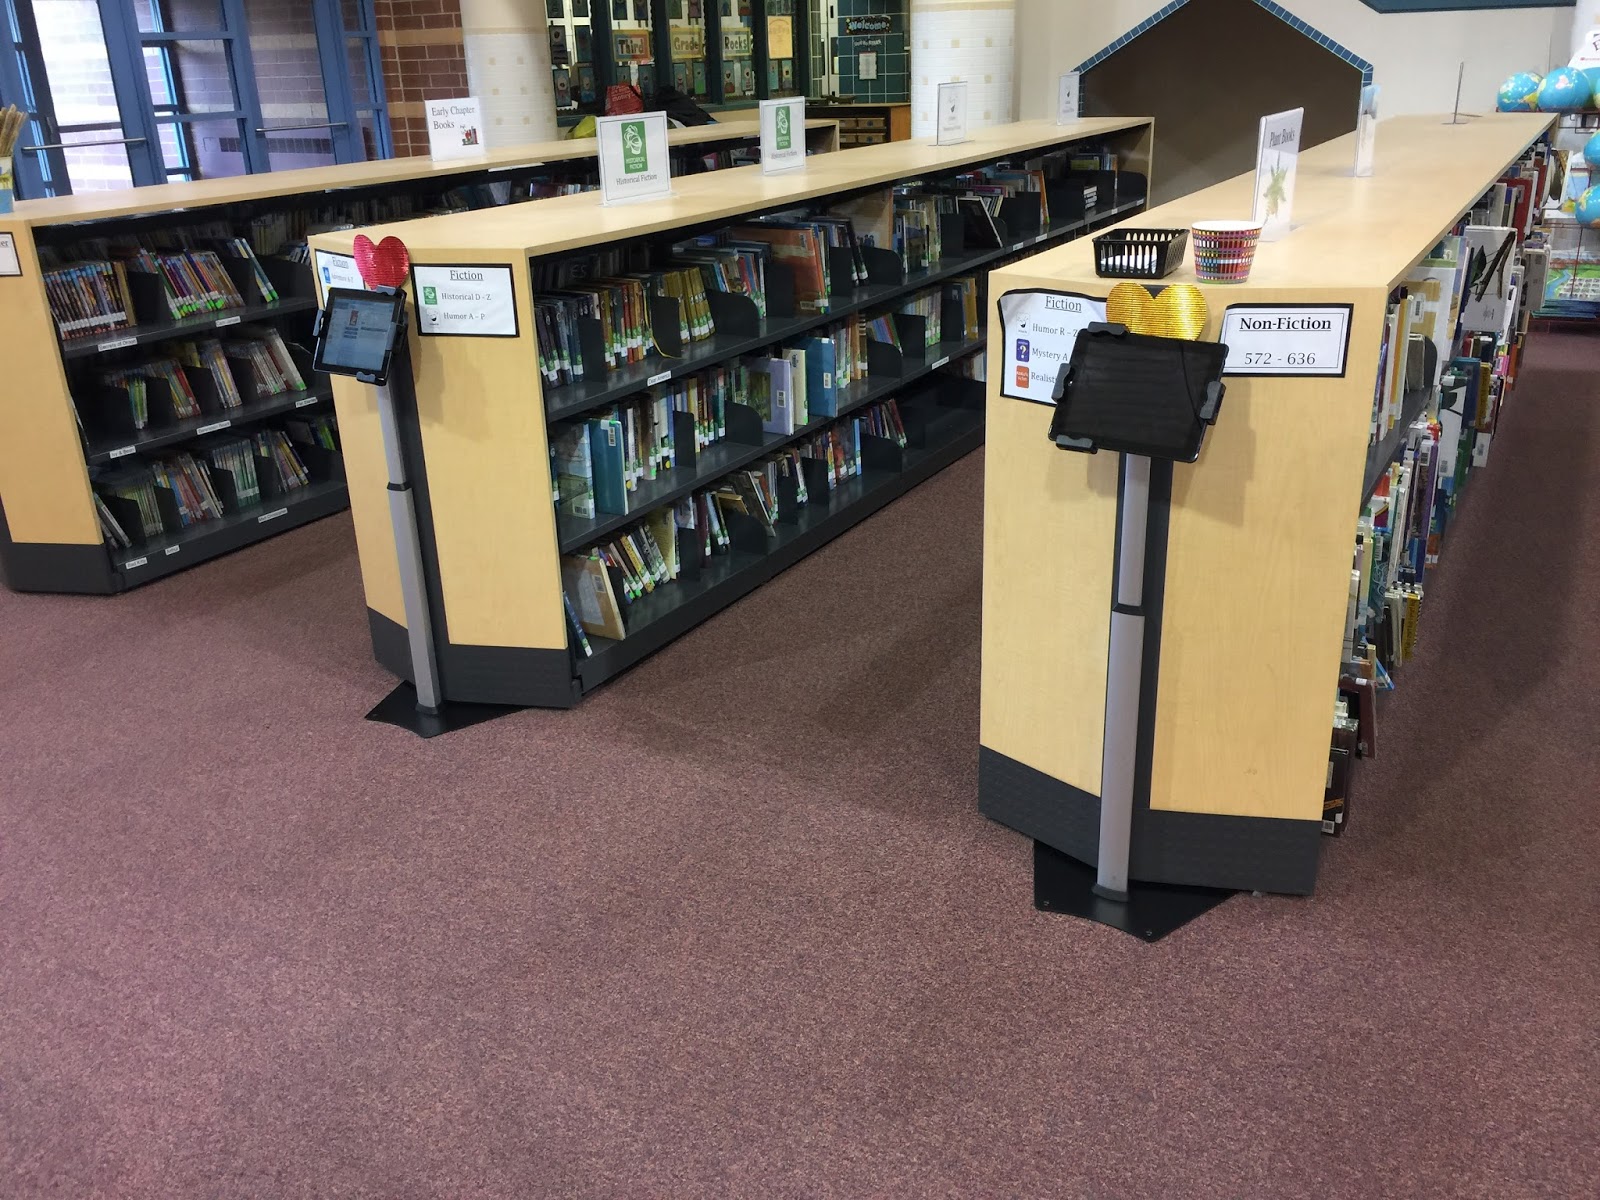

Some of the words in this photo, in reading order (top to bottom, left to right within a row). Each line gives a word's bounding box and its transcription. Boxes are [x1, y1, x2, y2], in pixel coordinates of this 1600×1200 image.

[849, 20, 887, 31] Welcome
[617, 38, 645, 54] Third
[674, 36, 700, 51] Grade
[724, 36, 748, 50] Rocks
[431, 107, 449, 117] Early
[450, 106, 475, 116] Chapter
[433, 120, 455, 130] Books
[616, 174, 641, 186] Historical
[641, 174, 658, 182] Fiction
[332, 256, 349, 269] Fiction
[449, 269, 484, 281] Fiction
[441, 292, 474, 301] Historical
[475, 293, 481, 301] D
[486, 293, 492, 301] Z
[1045, 295, 1082, 313] Fiction
[443, 312, 468, 320] Humor
[1239, 316, 1332, 331] Non-Fiction
[1032, 323, 1059, 335] Humor
[1059, 326, 1065, 336] R
[1072, 328, 1079, 338] Z
[1031, 347, 1061, 361] Mystery
[1062, 353, 1068, 361] A
[1244, 352, 1272, 365] 572
[1287, 352, 1316, 365] 636
[1031, 372, 1057, 384] Realist
